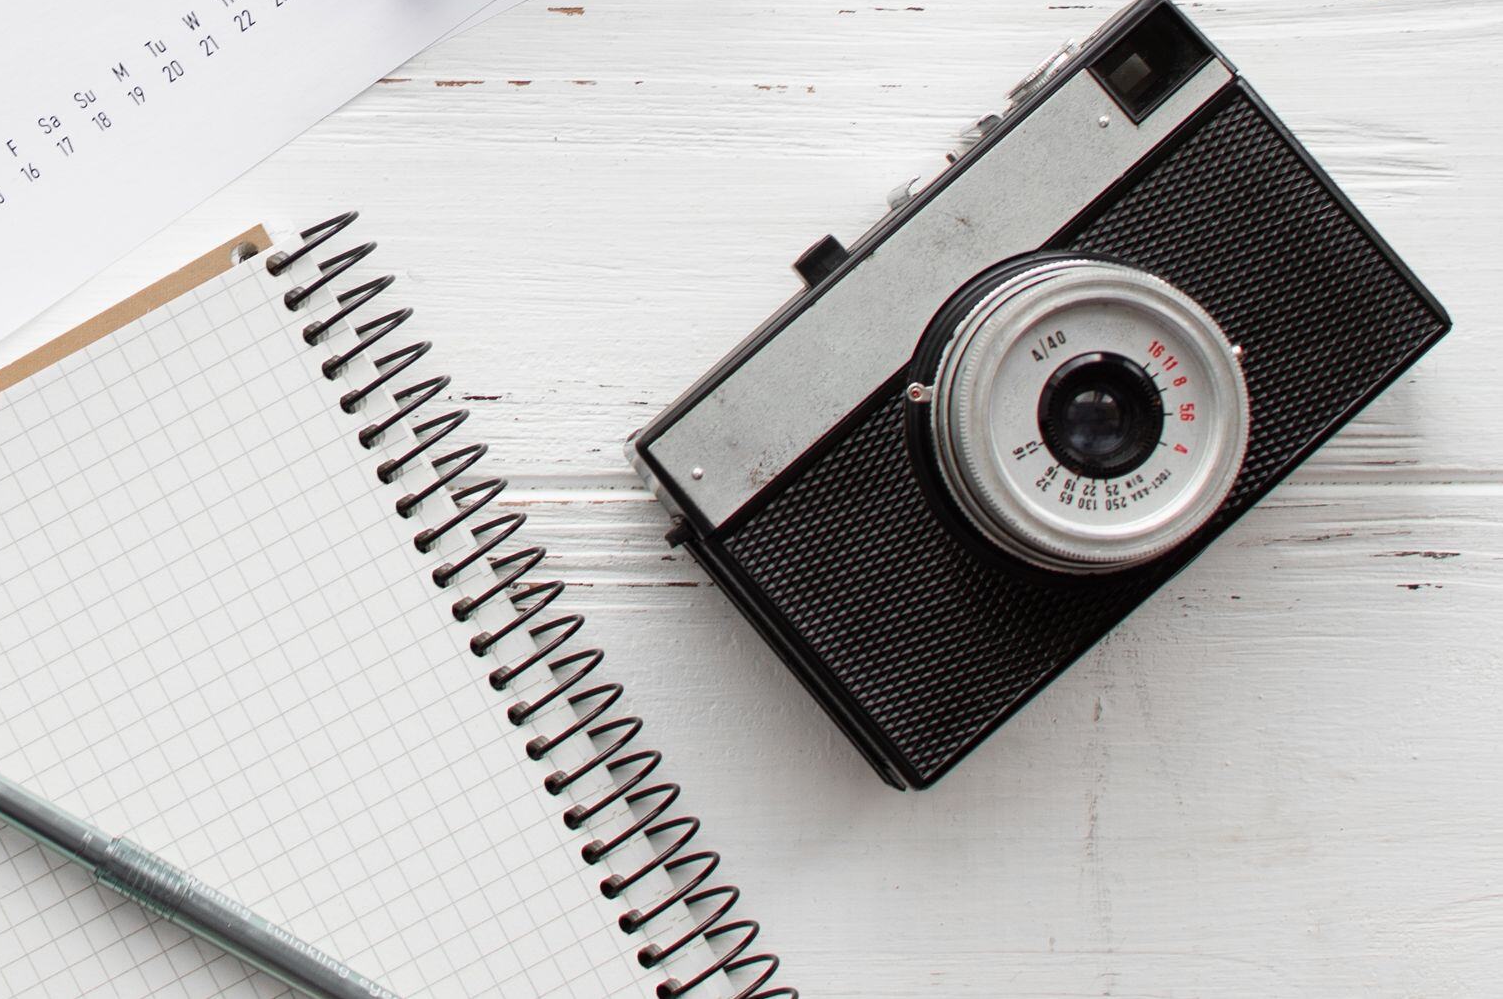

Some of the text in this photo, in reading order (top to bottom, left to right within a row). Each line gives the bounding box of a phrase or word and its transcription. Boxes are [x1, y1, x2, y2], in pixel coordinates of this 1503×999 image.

[5, 138, 18, 158] F
[37, 115, 62, 135] Sa
[73, 89, 97, 109] Su
[111, 61, 131, 83] M
[143, 39, 167, 58] Tu
[181, 10, 201, 32] W
[19, 162, 41, 183] 16
[56, 135, 75, 157] 17
[91, 111, 112, 132] 18
[127, 85, 146, 107] 19
[161, 59, 185, 84] 20
[198, 34, 220, 58] 21
[233, 9, 257, 33] 22
[1148, 340, 1166, 359] 16
[1162, 355, 1179, 372] 11
[1173, 375, 1187, 387] 8
[1082, 484, 1097, 497] 22
[1105, 484, 1120, 496] 25
[1078, 497, 1098, 511] 130
[1105, 496, 1128, 511] 250
